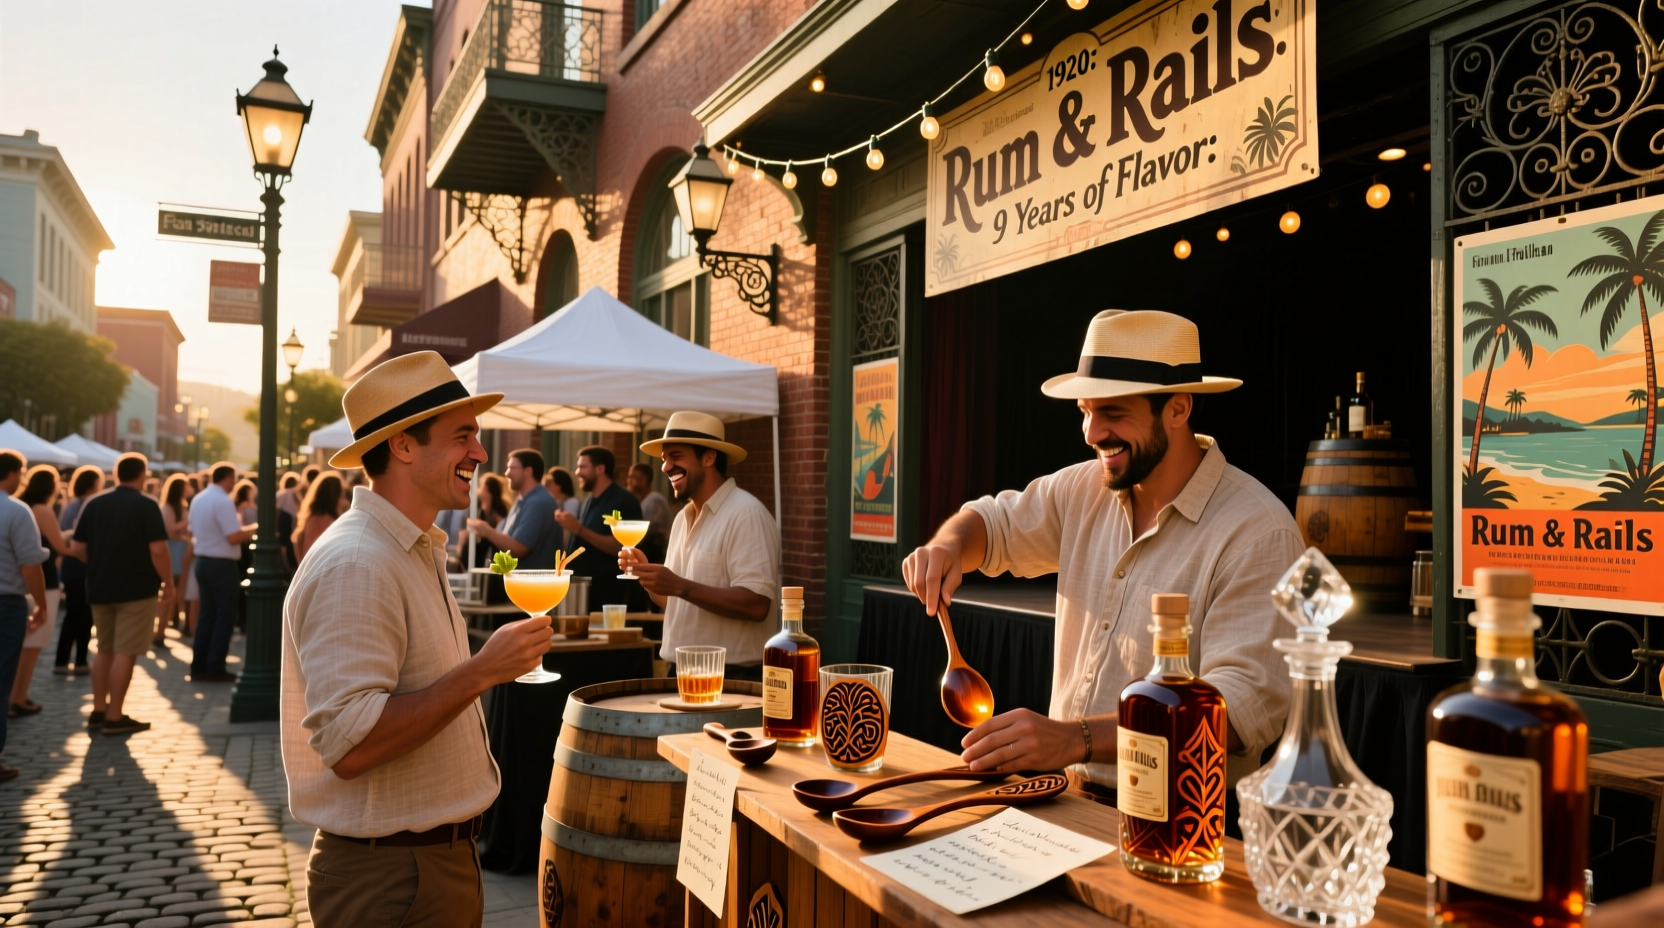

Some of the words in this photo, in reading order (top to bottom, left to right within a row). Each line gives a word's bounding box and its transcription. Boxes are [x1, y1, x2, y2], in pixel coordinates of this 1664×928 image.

[1047, 48, 1097, 92] 1920:
[942, 130, 1042, 234] Rum
[1053, 90, 1097, 168] &
[992, 209, 1008, 246] 9
[1014, 190, 1076, 236] Years
[1083, 162, 1114, 216] of
[1115, 134, 1218, 200] Flavor:
[1471, 514, 1535, 547] Rum
[1542, 518, 1566, 548] &
[1573, 518, 1654, 553] Rails
